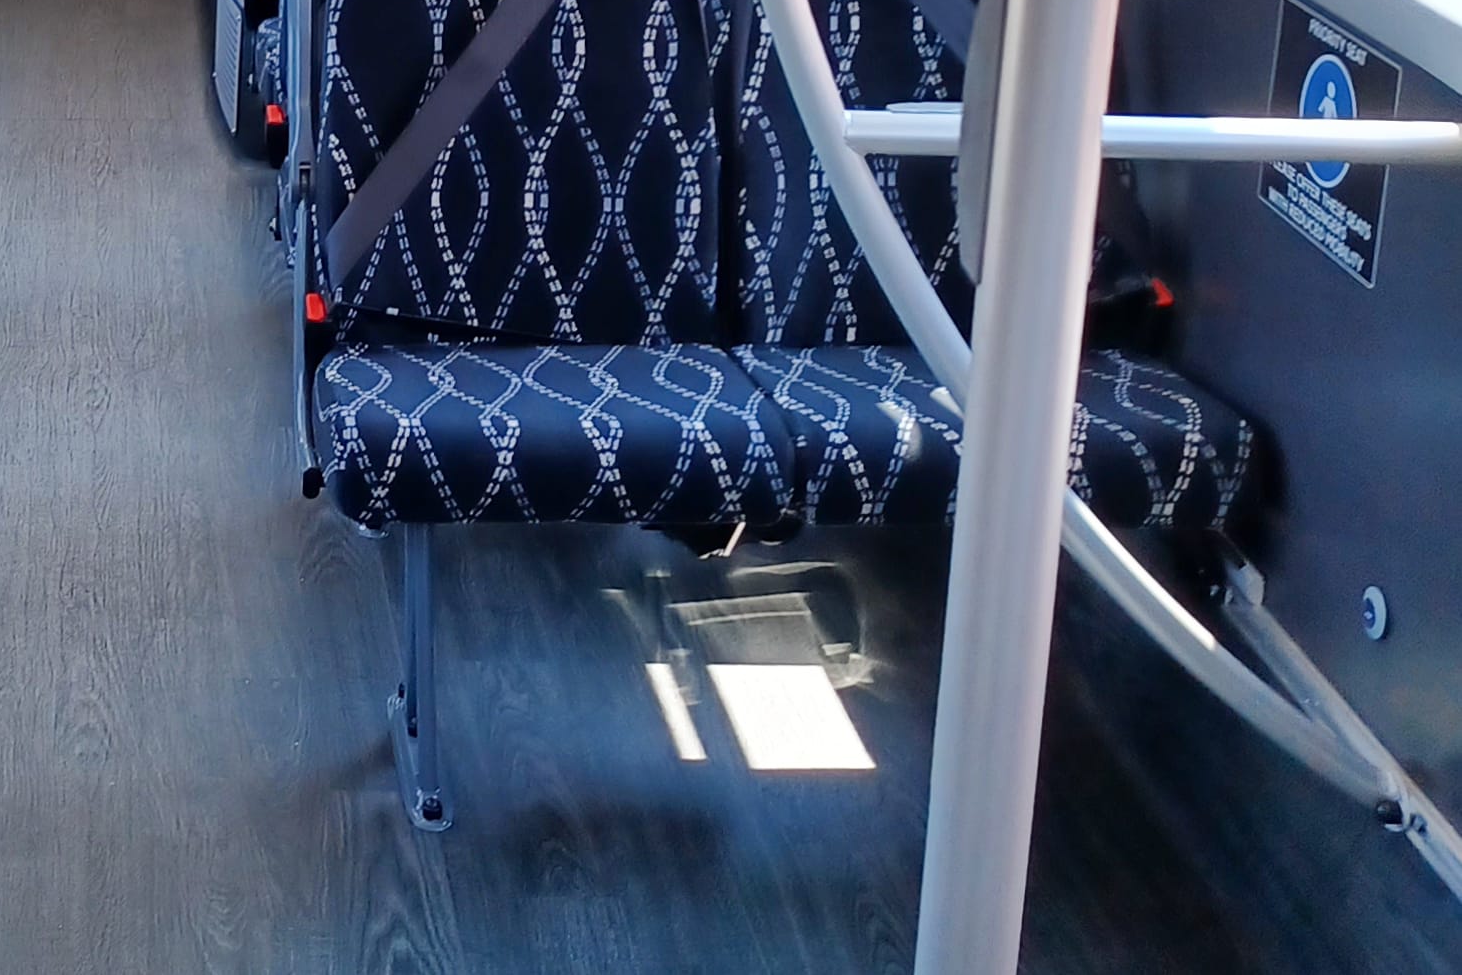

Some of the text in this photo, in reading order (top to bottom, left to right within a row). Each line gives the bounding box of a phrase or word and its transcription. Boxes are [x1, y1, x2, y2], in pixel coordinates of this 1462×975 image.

[1308, 18, 1368, 67] PRIORITY SEAT
[1287, 182, 1348, 241] TO PASSENGERS
[1288, 203, 1325, 242] REDUCED
[1324, 232, 1366, 273] MOBILITY
[1296, 172, 1321, 202] OFFER
[1322, 190, 1348, 222] THESE
[1345, 210, 1373, 241] SEATS
